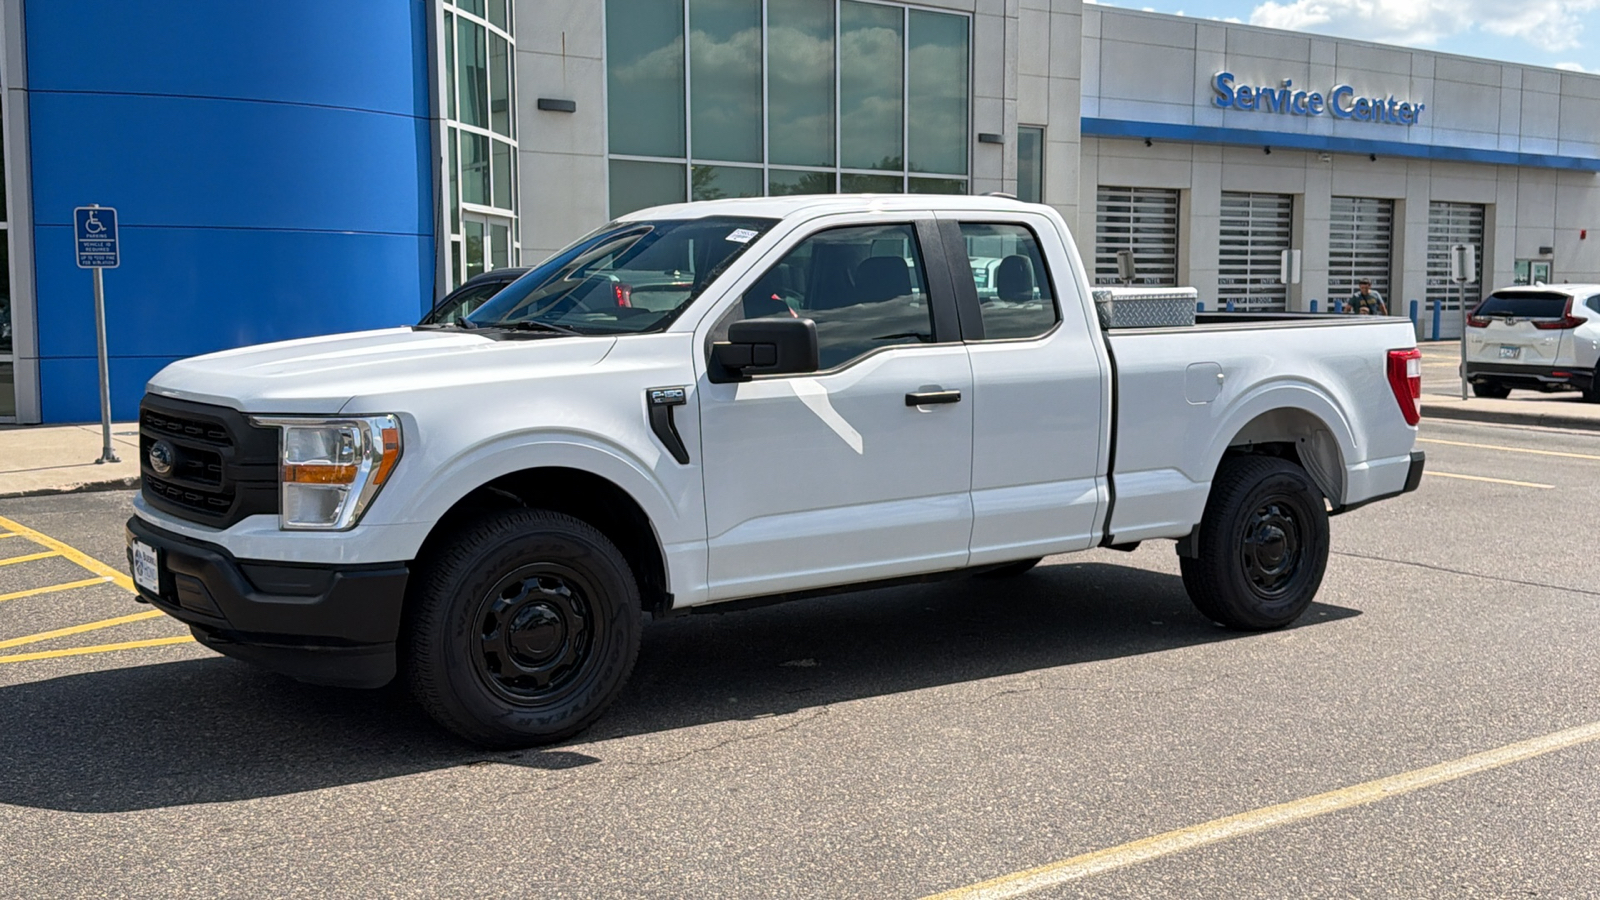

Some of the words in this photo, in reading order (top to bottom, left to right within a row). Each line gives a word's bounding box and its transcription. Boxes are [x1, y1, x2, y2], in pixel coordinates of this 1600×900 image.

[1211, 70, 1324, 116] Service
[1328, 84, 1425, 125] Center
[652, 390, 684, 399] F-150
